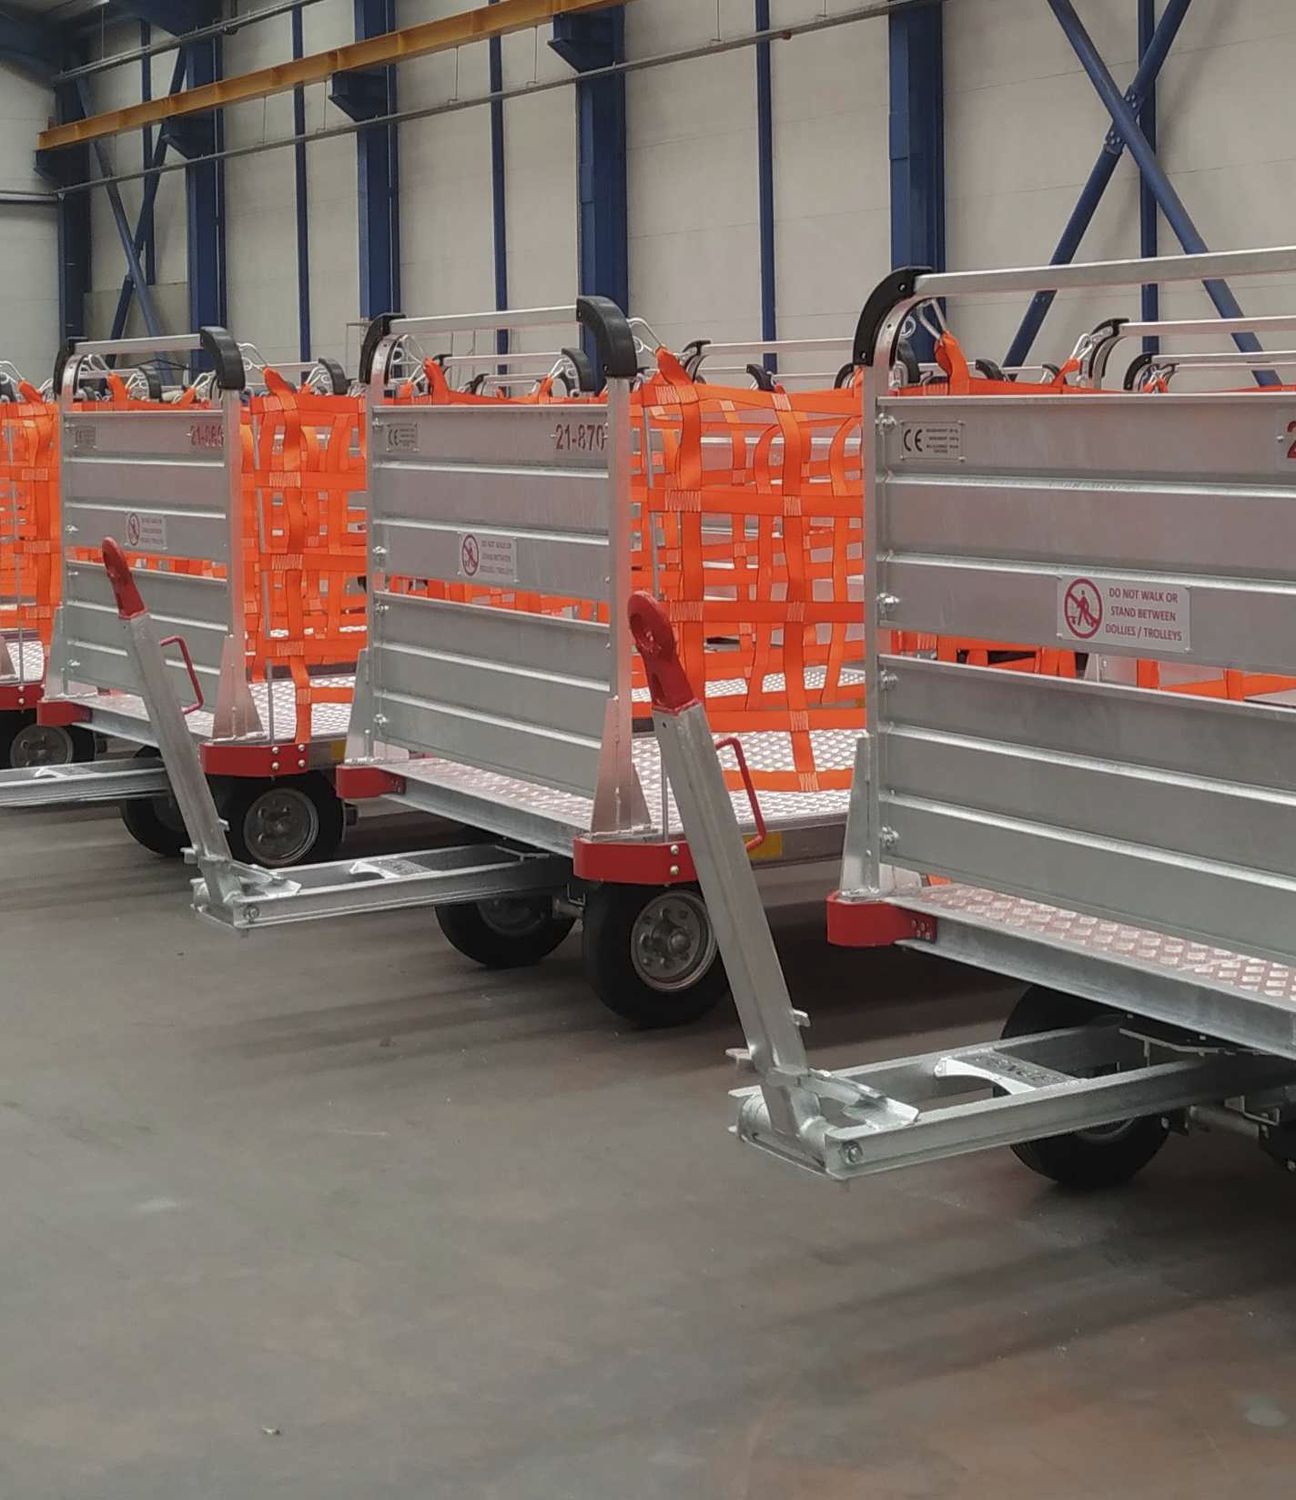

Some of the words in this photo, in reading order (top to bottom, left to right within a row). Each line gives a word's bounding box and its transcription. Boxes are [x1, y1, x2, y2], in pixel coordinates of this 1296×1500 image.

[555, 424, 605, 451] 21-870
[904, 428, 923, 452] CE
[1109, 587, 1121, 598] DO
[1122, 588, 1140, 600] NOT
[1141, 590, 1164, 602] WALK
[1165, 592, 1178, 603] OR
[1110, 606, 1136, 617] STAND
[1137, 608, 1176, 621] BETWEEN
[1105, 623, 1136, 636] DOLLIES
[1143, 627, 1183, 641] TROLLEYS
